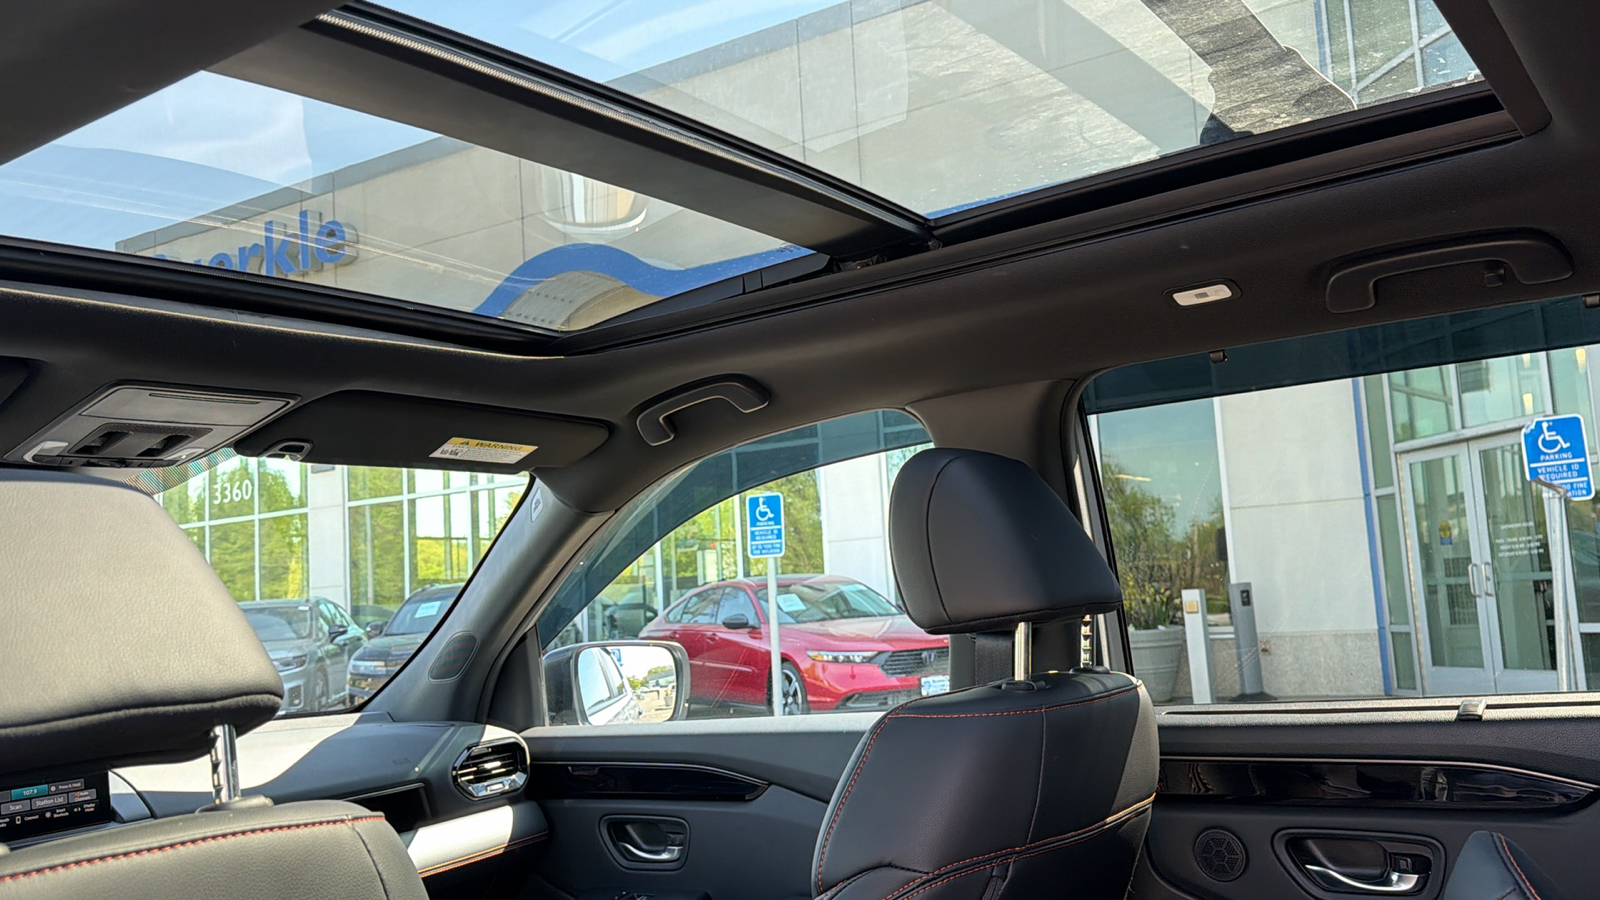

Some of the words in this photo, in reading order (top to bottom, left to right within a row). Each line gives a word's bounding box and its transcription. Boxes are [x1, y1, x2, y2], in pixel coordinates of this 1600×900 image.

[475, 441, 523, 451] WARNING
[1540, 452, 1573, 462] PARKING
[1537, 464, 1568, 474] VEHICLE
[1571, 463, 1580, 471] ID
[1573, 482, 1588, 490] FINE
[213, 479, 252, 505] 3360
[22, 788, 38, 796] 107.9
[35, 799, 54, 807] Station
